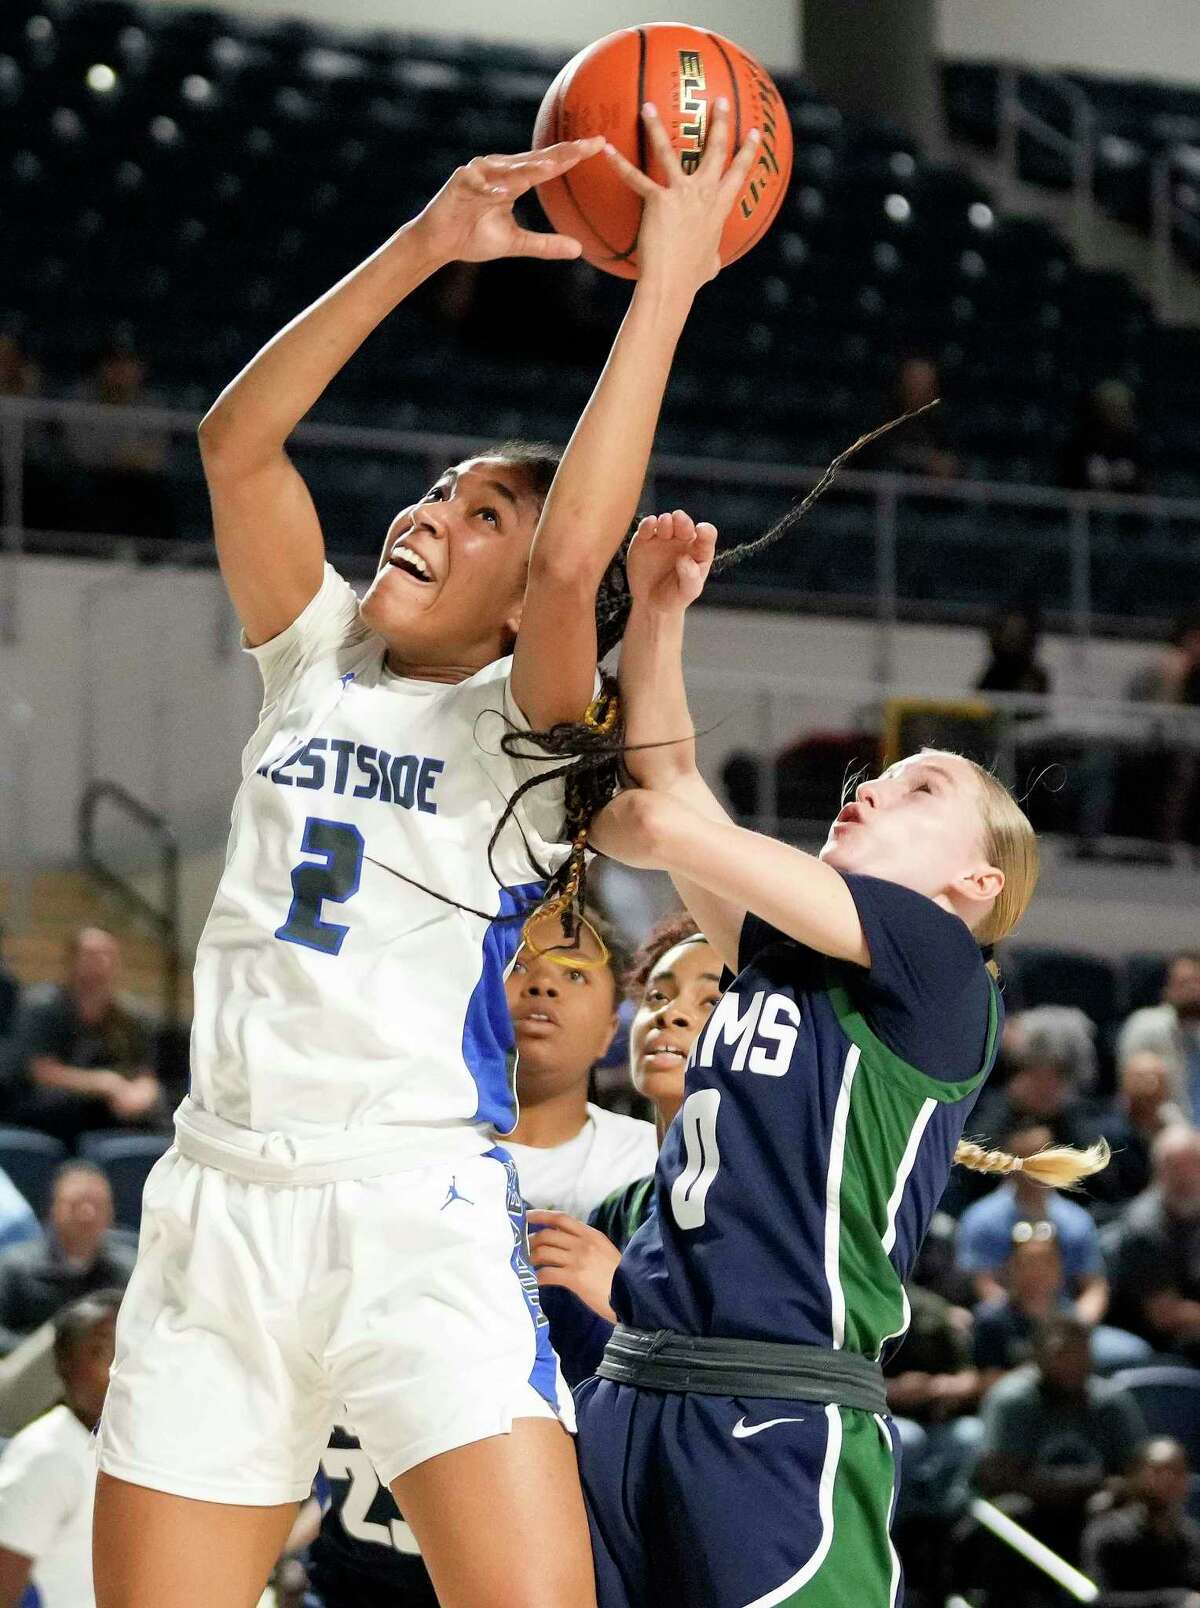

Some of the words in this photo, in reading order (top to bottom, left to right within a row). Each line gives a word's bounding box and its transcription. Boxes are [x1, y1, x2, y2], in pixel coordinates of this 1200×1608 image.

[274, 816, 365, 956] 2
[685, 987, 801, 1077] MS
[671, 1088, 721, 1231] 0
[320, 1447, 422, 1554] 2
